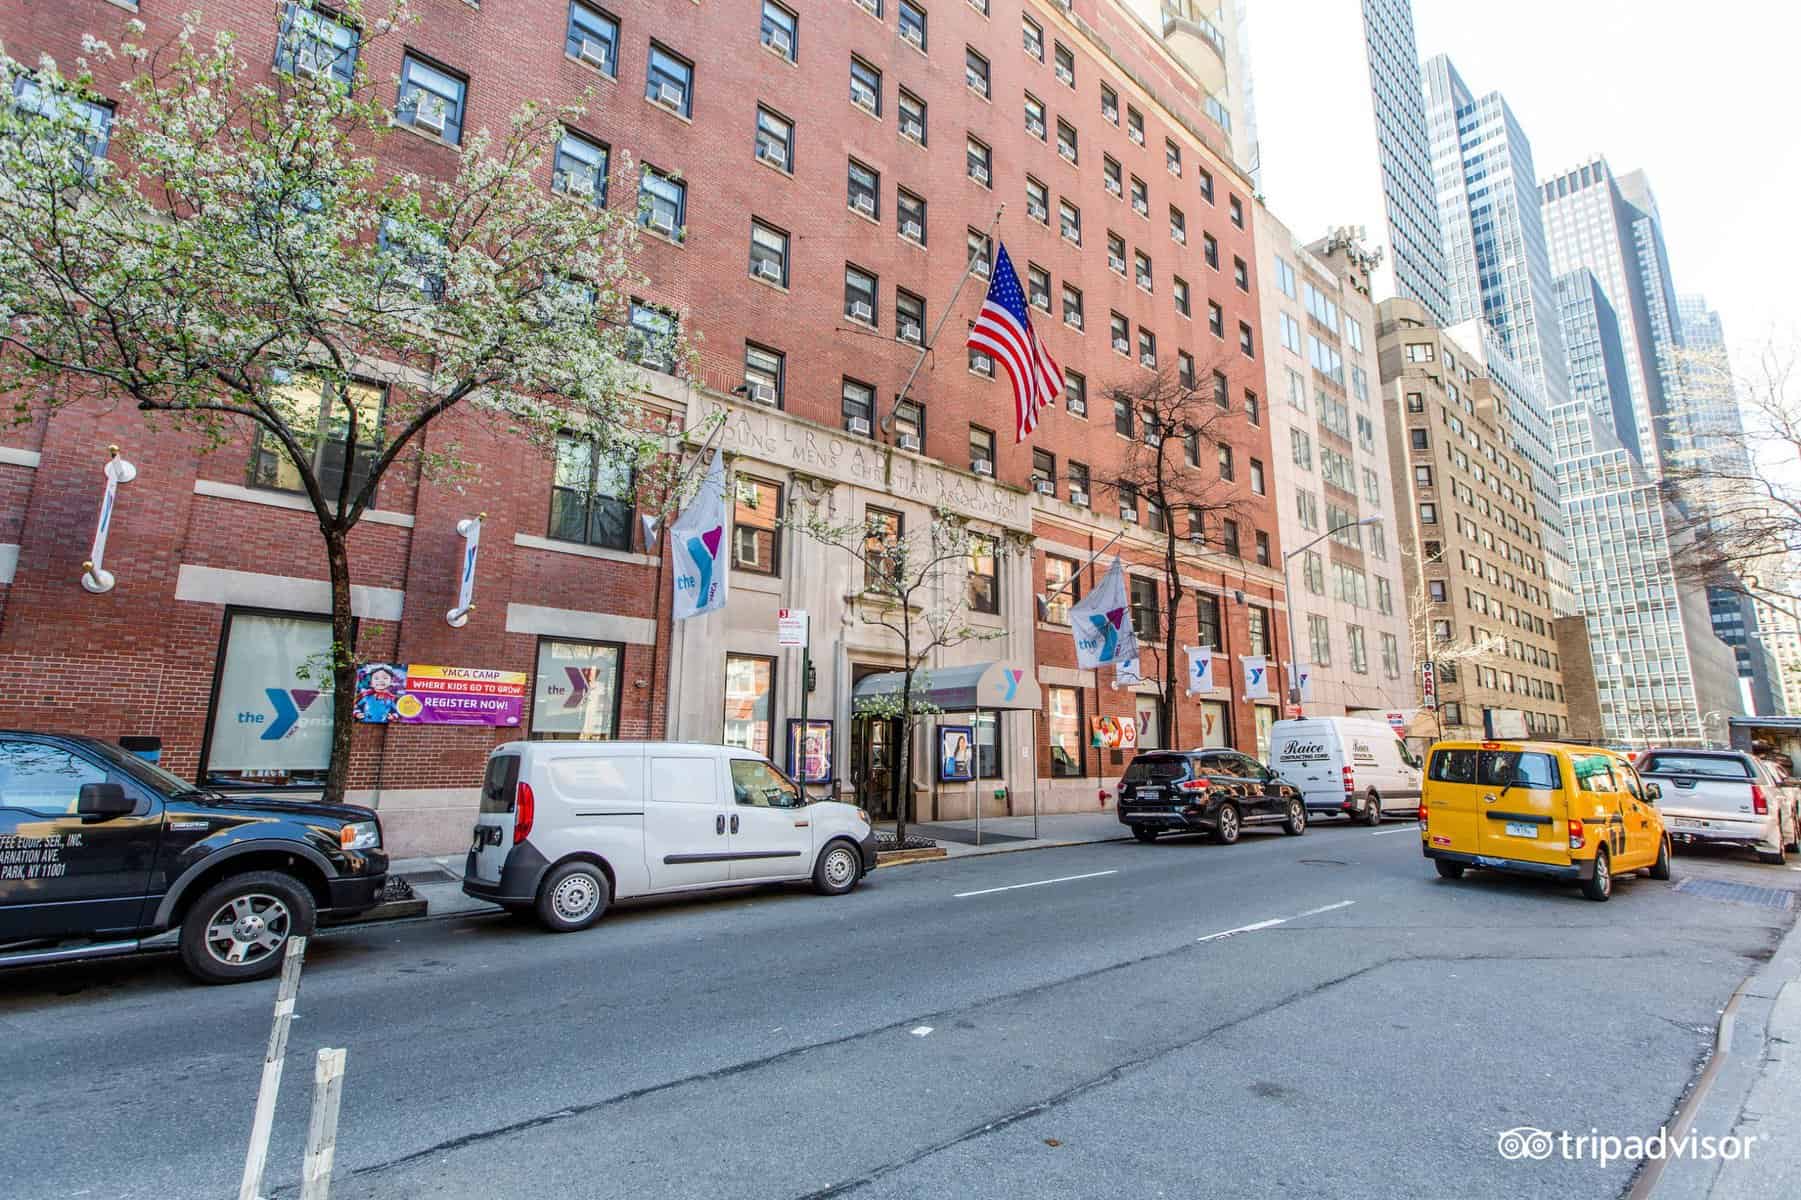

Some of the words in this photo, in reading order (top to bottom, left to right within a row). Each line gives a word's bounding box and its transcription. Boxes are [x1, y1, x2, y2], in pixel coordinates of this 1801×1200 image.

[792, 447, 838, 469] MENS
[677, 574, 697, 590] the
[441, 668, 470, 679] YMCA
[472, 670, 500, 680] CAMP
[412, 680, 446, 690] WHERE
[447, 681, 468, 691] KIDS
[470, 682, 482, 692] GO
[484, 683, 495, 692] TO
[497, 684, 521, 694] GROW
[547, 684, 566, 696] the
[1423, 671, 1434, 696] PARK
[424, 697, 478, 709] REGISTER
[480, 699, 509, 710] NOW!
[238, 711, 264, 723] the
[1283, 739, 1324, 755] Raice
[67, 833, 84, 847] INC.
[41, 848, 60, 863] AVE.
[1, 865, 25, 880] PARK,
[28, 864, 41, 878] NY
[42, 863, 66, 877] 11001
